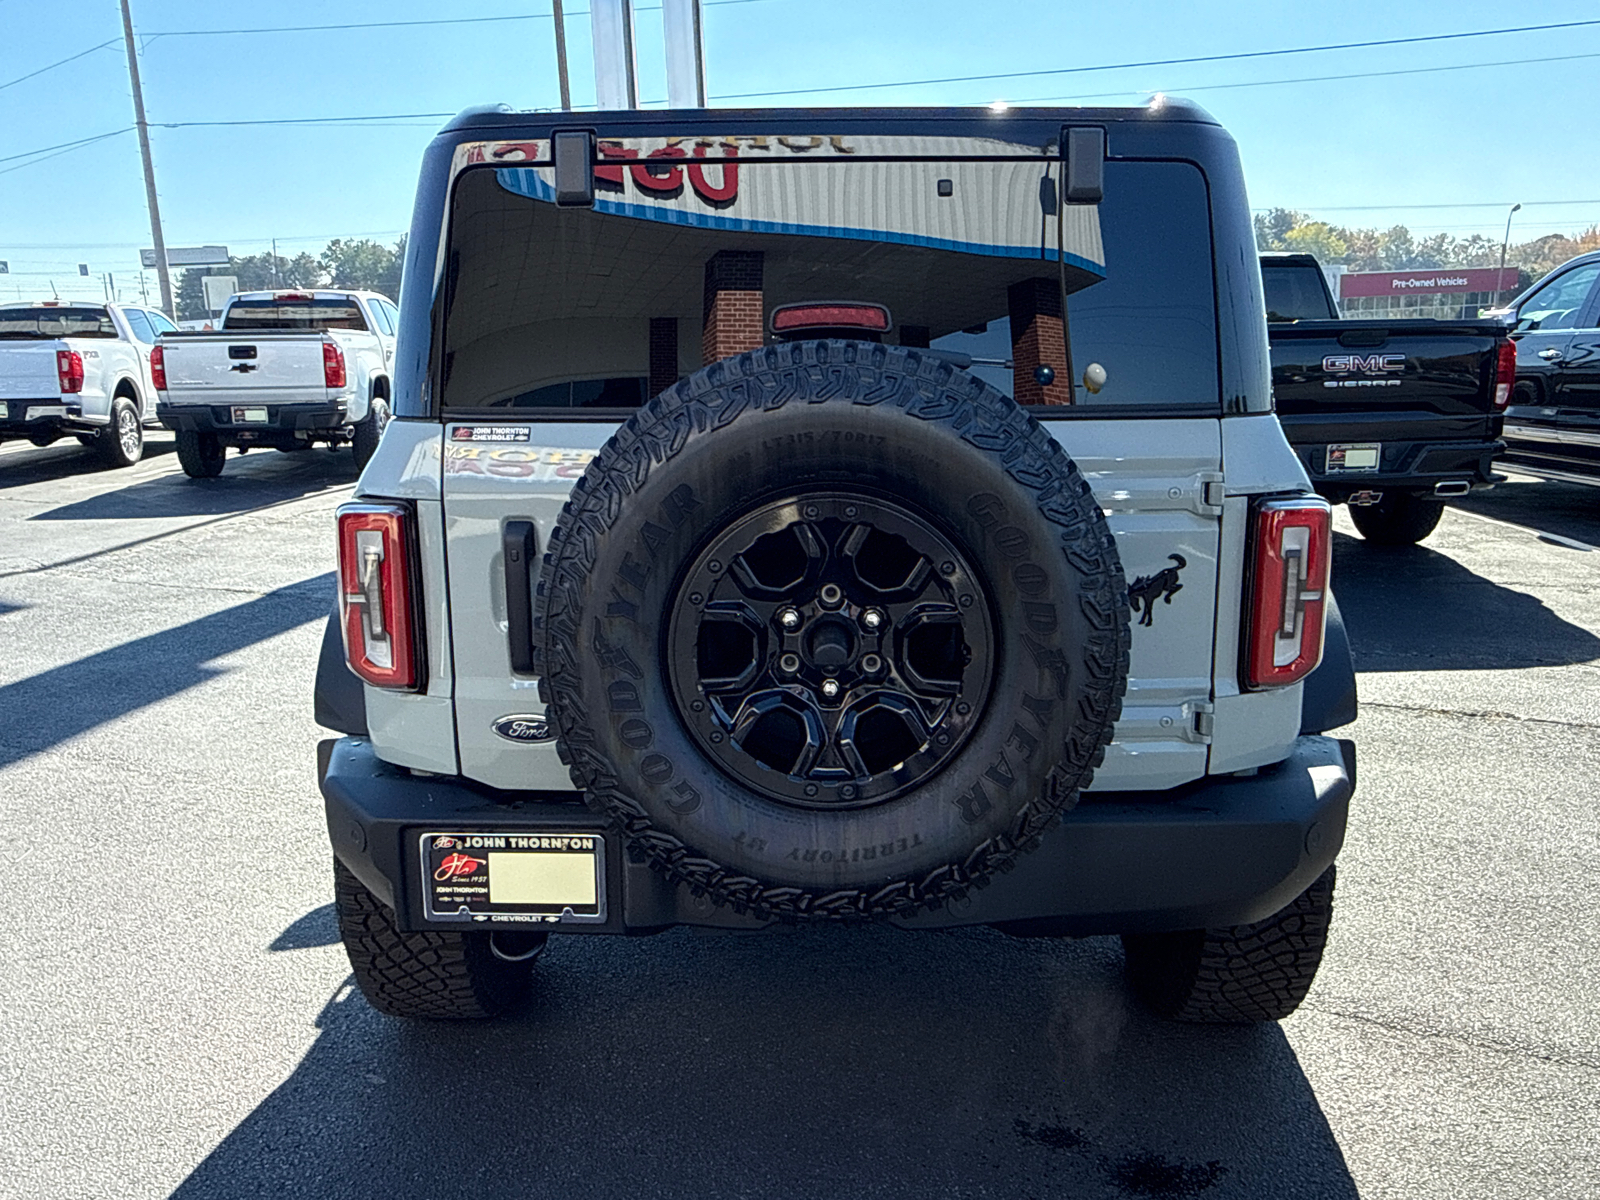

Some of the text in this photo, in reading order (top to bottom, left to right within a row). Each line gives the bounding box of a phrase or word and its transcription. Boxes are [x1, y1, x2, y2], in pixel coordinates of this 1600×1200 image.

[1392, 277, 1468, 289] Pre-Owned Vehicles
[1322, 354, 1406, 372] GMC
[592, 483, 703, 815] GOODYEAR
[952, 492, 1070, 825] GOODYEAR
[509, 721, 549, 738] Ford
[464, 837, 506, 848] JOHN
[509, 837, 594, 850] THORNTON
